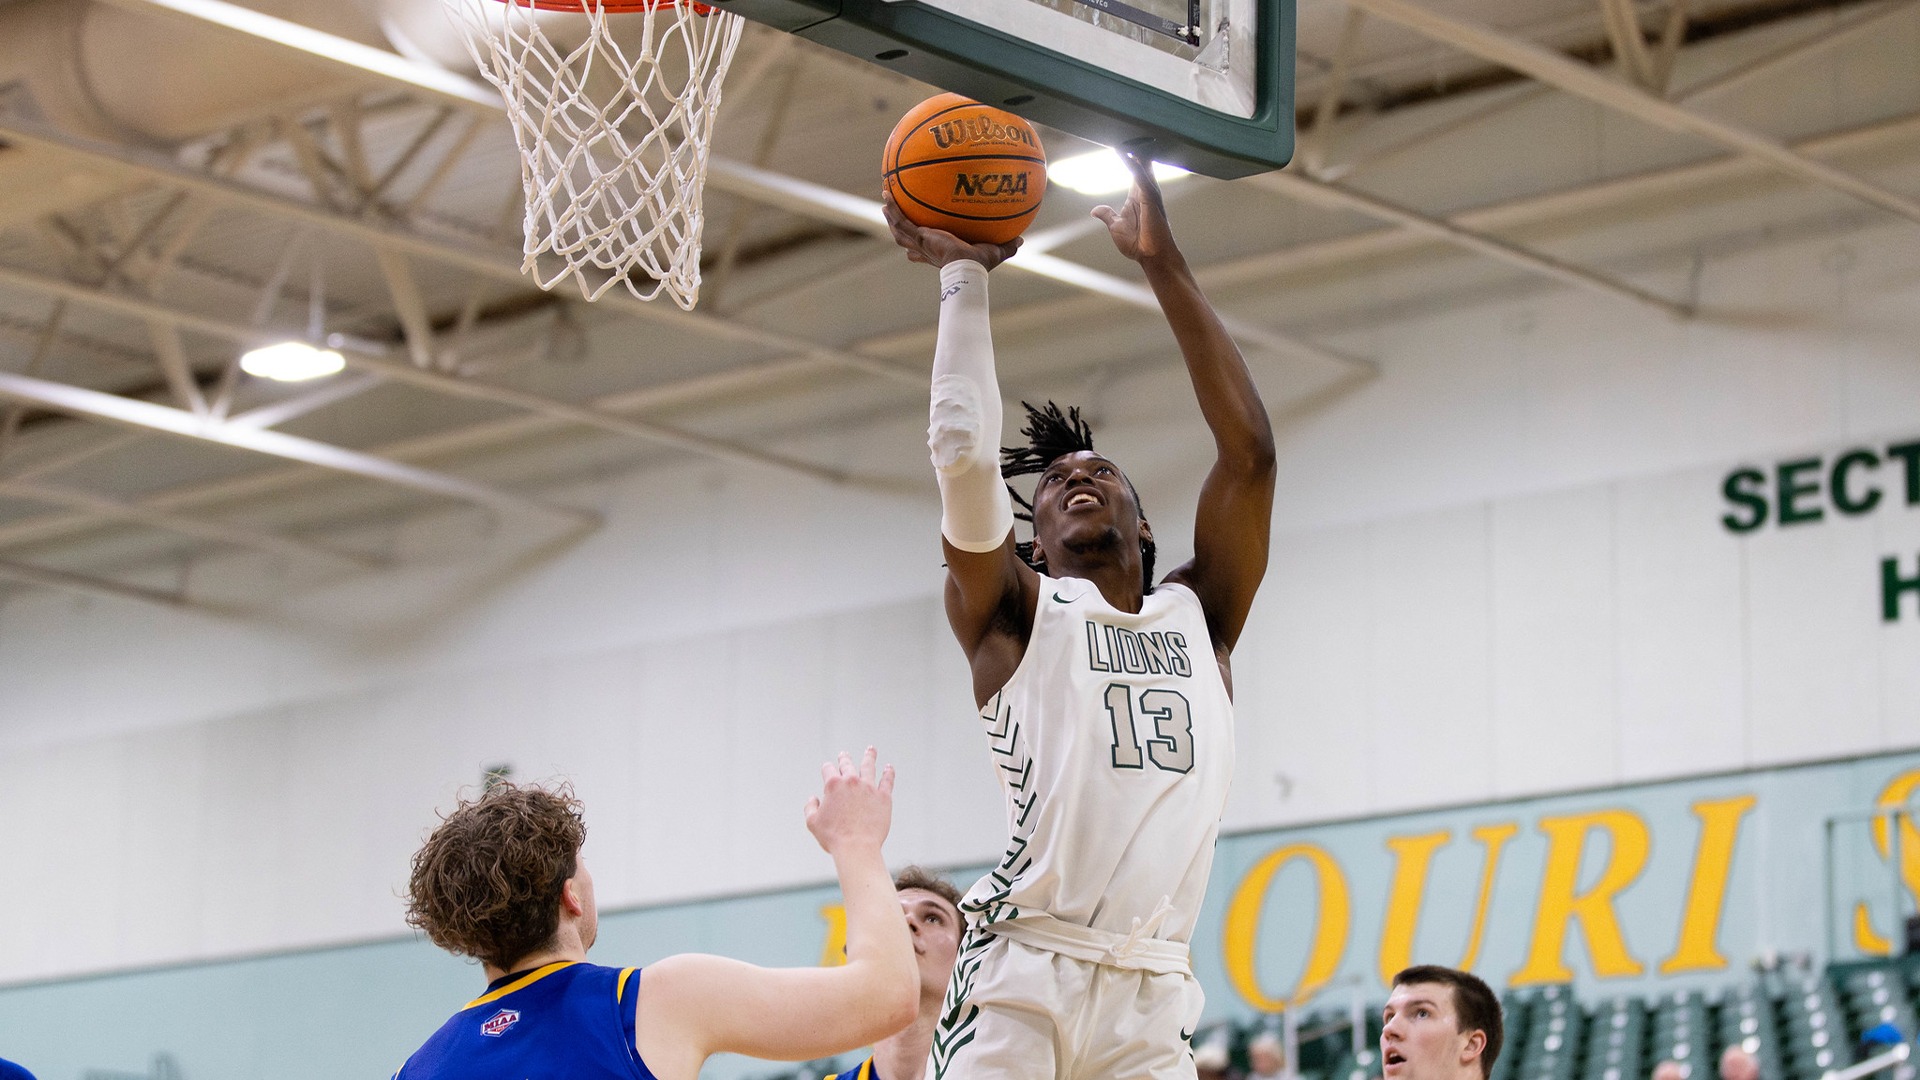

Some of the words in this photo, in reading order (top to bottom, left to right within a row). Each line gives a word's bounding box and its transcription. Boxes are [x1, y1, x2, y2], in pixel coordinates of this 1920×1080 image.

[928, 114, 1034, 149] Wilson
[952, 171, 1028, 196] NCAA
[1086, 621, 1192, 678] LIONS
[1104, 683, 1195, 774] 13
[485, 1014, 517, 1032] MIAA
